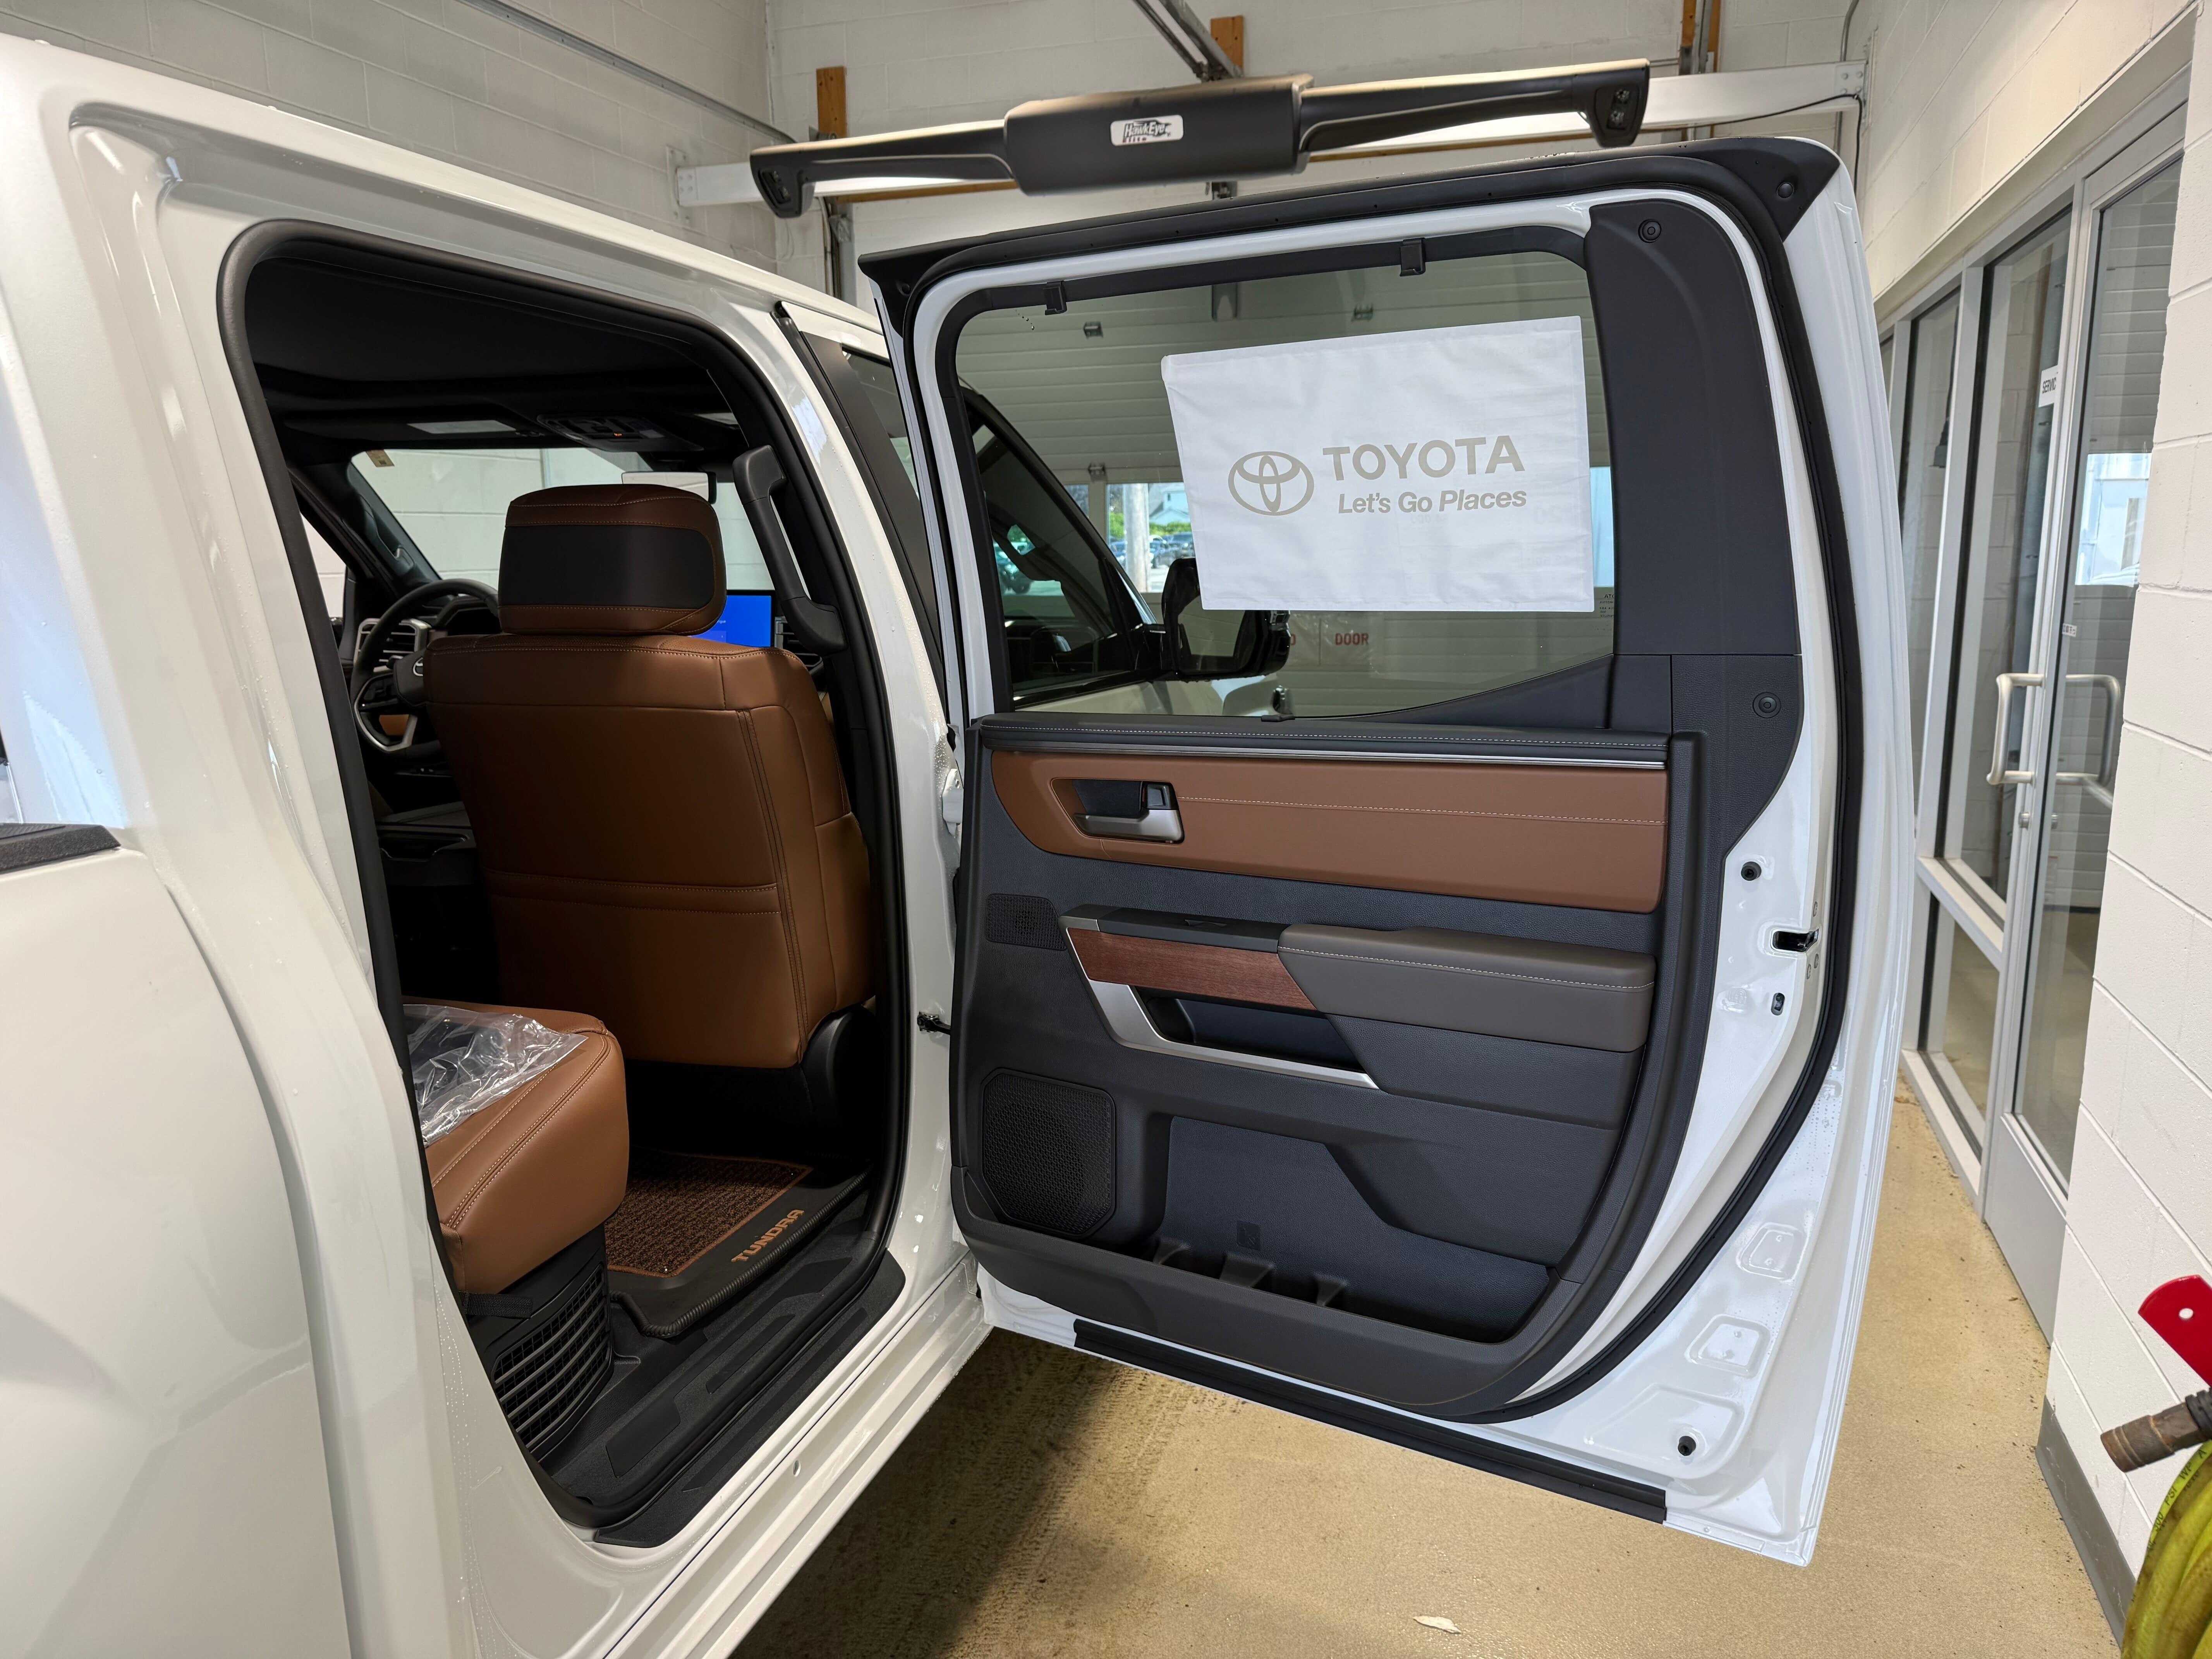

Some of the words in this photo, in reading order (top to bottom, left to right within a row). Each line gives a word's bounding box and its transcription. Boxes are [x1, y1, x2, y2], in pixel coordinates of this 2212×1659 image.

[1123, 121, 1166, 137] HawkEye
[1323, 435, 1523, 480] TOYOTA
[1399, 492, 1432, 512] Go
[1440, 490, 1526, 510] Places
[1335, 632, 1369, 646] DOOR
[731, 1209, 805, 1262] TUNDRA
[2164, 1486, 2178, 1506] PSI
